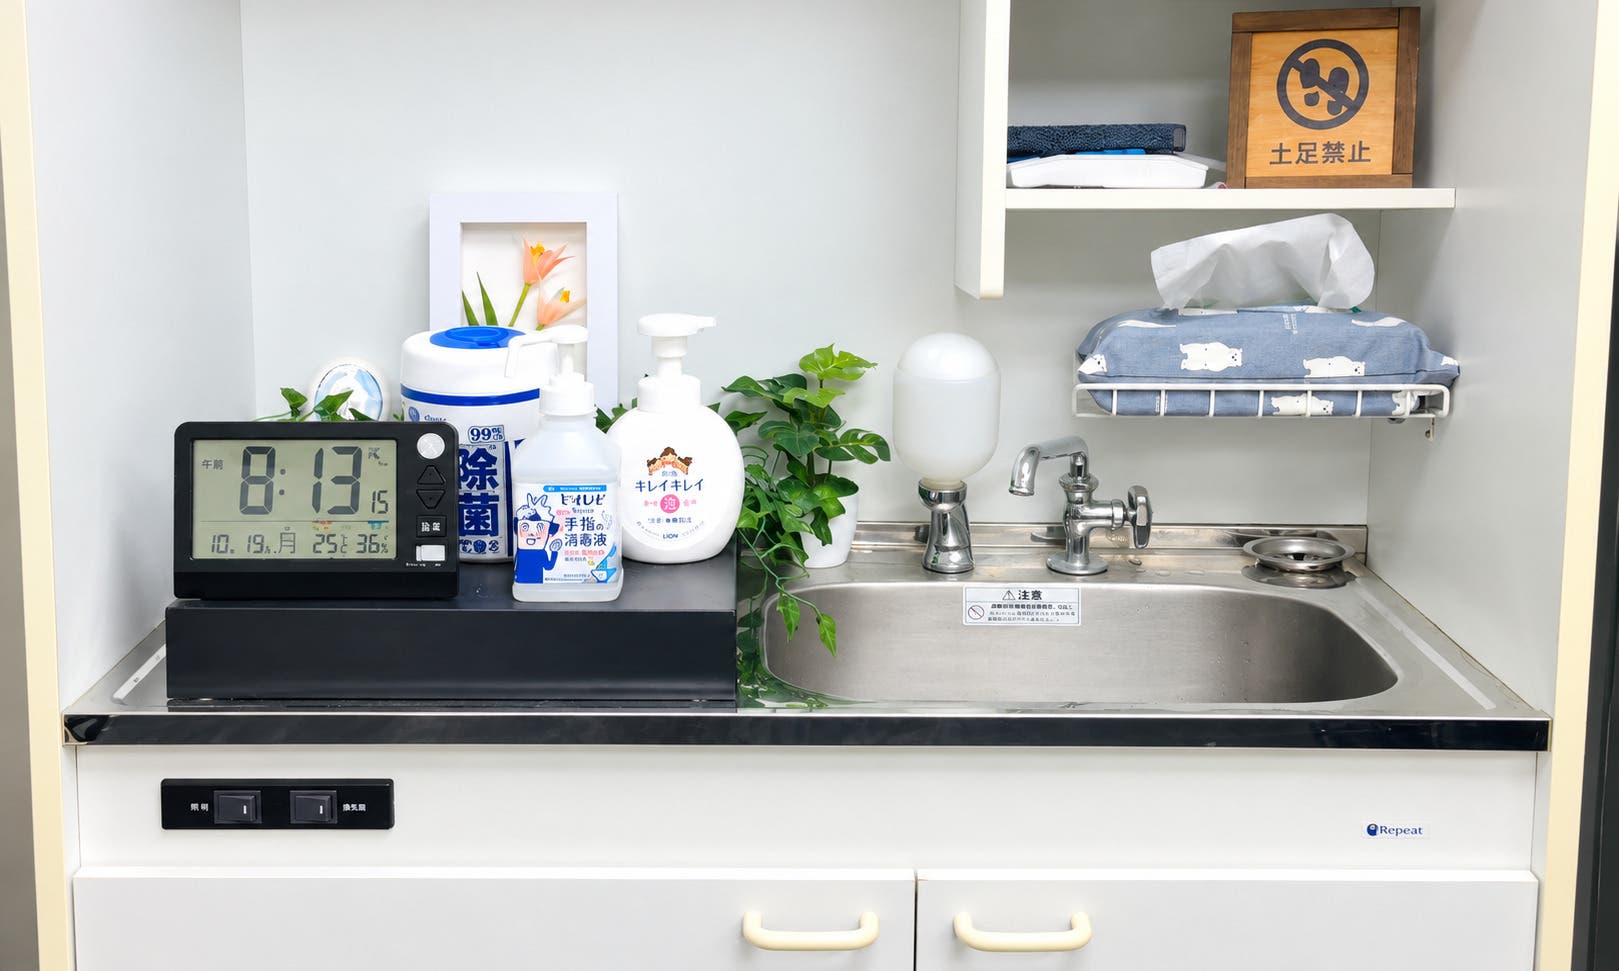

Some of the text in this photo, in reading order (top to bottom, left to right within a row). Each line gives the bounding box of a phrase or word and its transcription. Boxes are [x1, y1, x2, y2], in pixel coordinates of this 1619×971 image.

[1269, 140, 1371, 165] 土足禁止
[201, 459, 224, 470] 午前
[239, 446, 363, 515] 8:13
[635, 478, 704, 492] キレイキレイ
[457, 446, 500, 538] 除菌
[372, 489, 389, 514] 15
[564, 516, 604, 532] 手指の
[564, 533, 607, 547] 消毒液
[1018, 589, 1043, 601] 注意
[1380, 825, 1424, 837] Repeat
